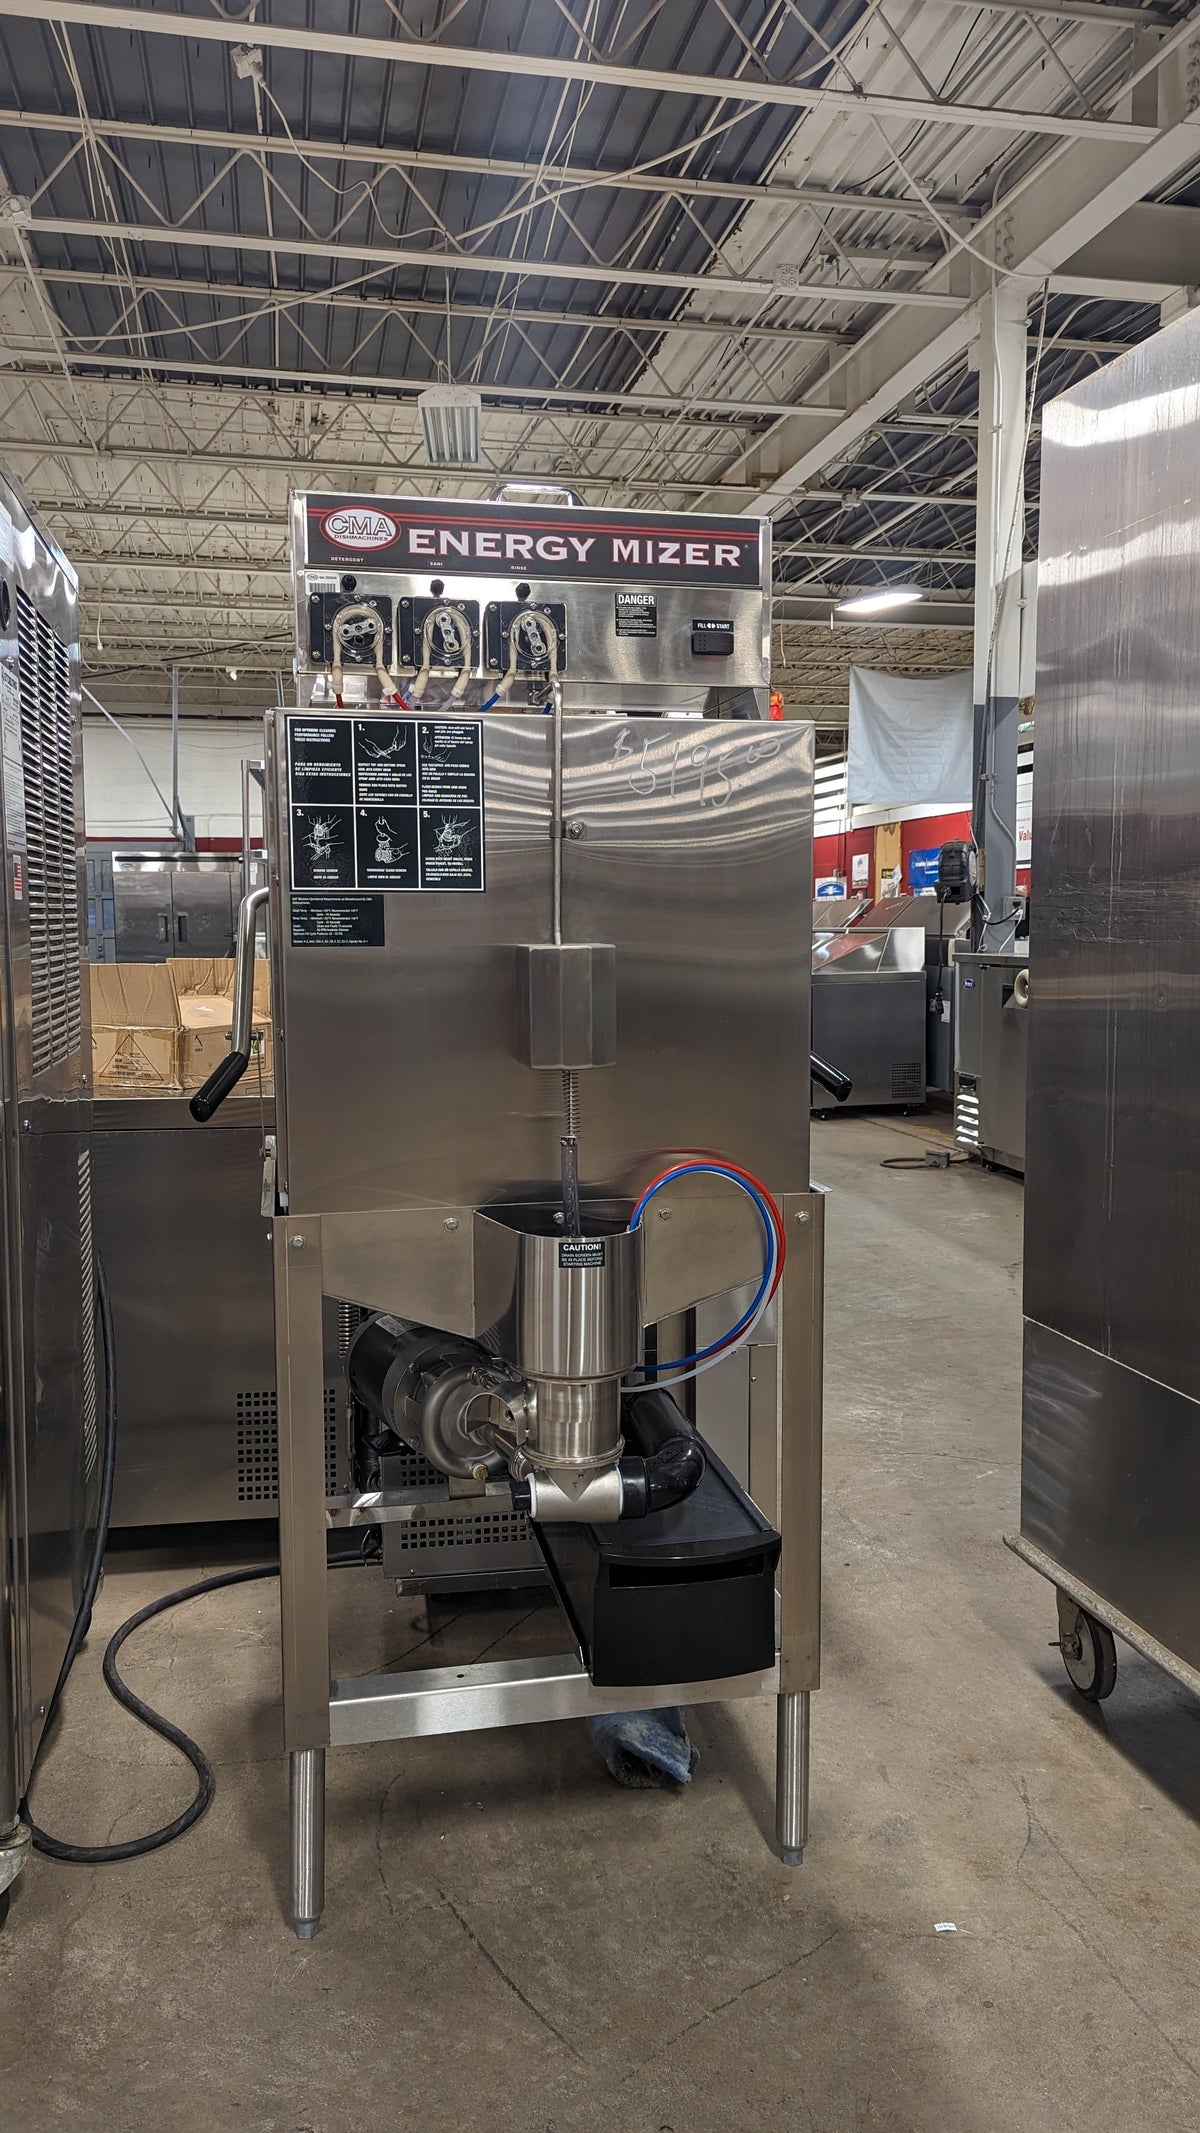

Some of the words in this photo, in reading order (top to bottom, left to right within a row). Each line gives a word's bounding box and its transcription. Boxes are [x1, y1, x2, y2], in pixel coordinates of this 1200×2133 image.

[328, 515, 393, 537] CMA
[334, 534, 389, 542] DISHMACHINES
[408, 527, 597, 563] ENERGY
[612, 537, 741, 567] MIZER
[618, 594, 655, 605] DANGER
[357, 723, 365, 731] 1.
[421, 726, 429, 734] 2.
[296, 809, 304, 817] 3.
[360, 809, 368, 817] 4.
[422, 810, 431, 818] 5.
[563, 1243, 602, 1251] CAUTION!
